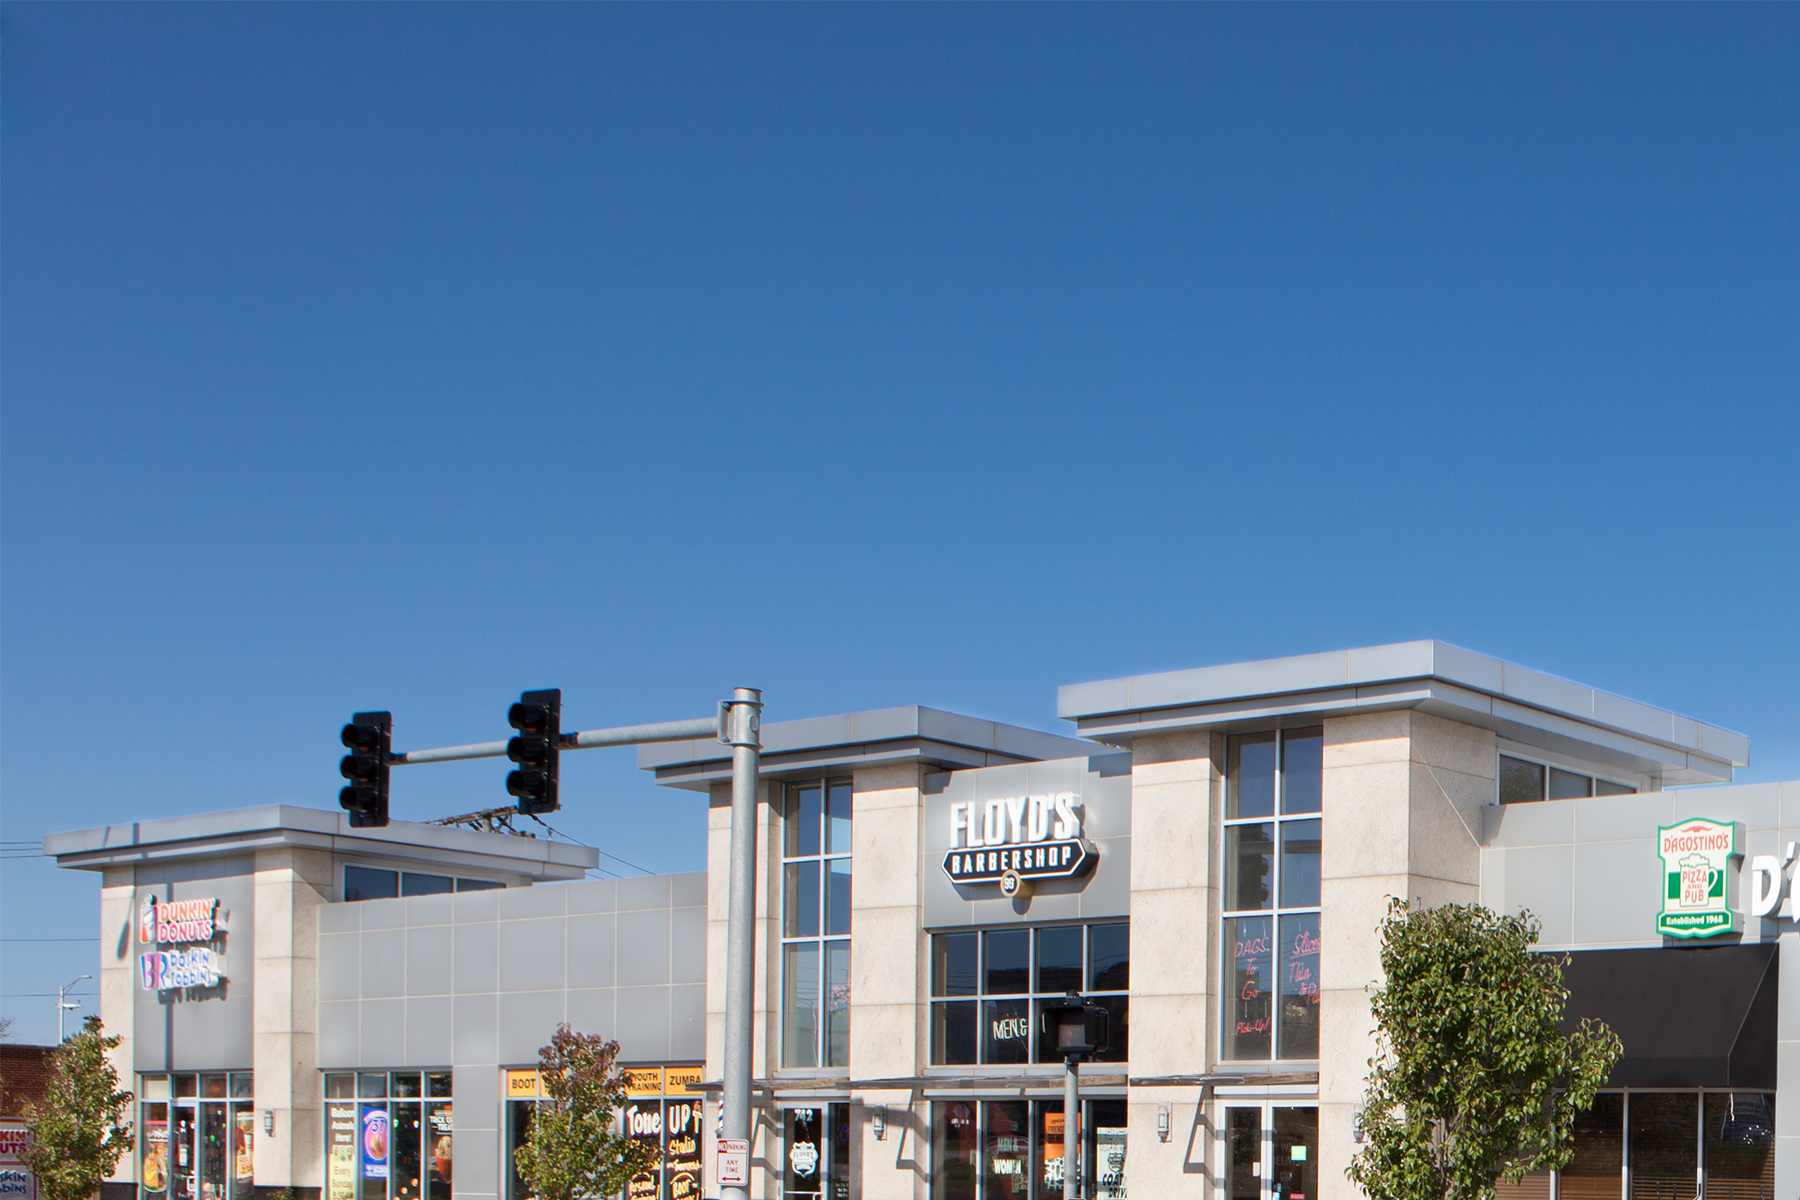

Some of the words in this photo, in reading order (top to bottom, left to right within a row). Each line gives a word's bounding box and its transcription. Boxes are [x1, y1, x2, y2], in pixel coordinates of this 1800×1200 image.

[951, 792, 1080, 848] FLOYD'S
[1664, 831, 1729, 854] D'AGOSTINO'S
[952, 846, 1072, 875] BARBERSHOP
[1682, 868, 1708, 884] PIZZA
[1684, 889, 1705, 904] PUB
[159, 899, 217, 922] DUNKIN'
[1666, 915, 1705, 926] Established
[1706, 914, 1724, 925] 1968
[159, 919, 213, 943] DONUTS
[630, 1082, 662, 1091] RAINING
